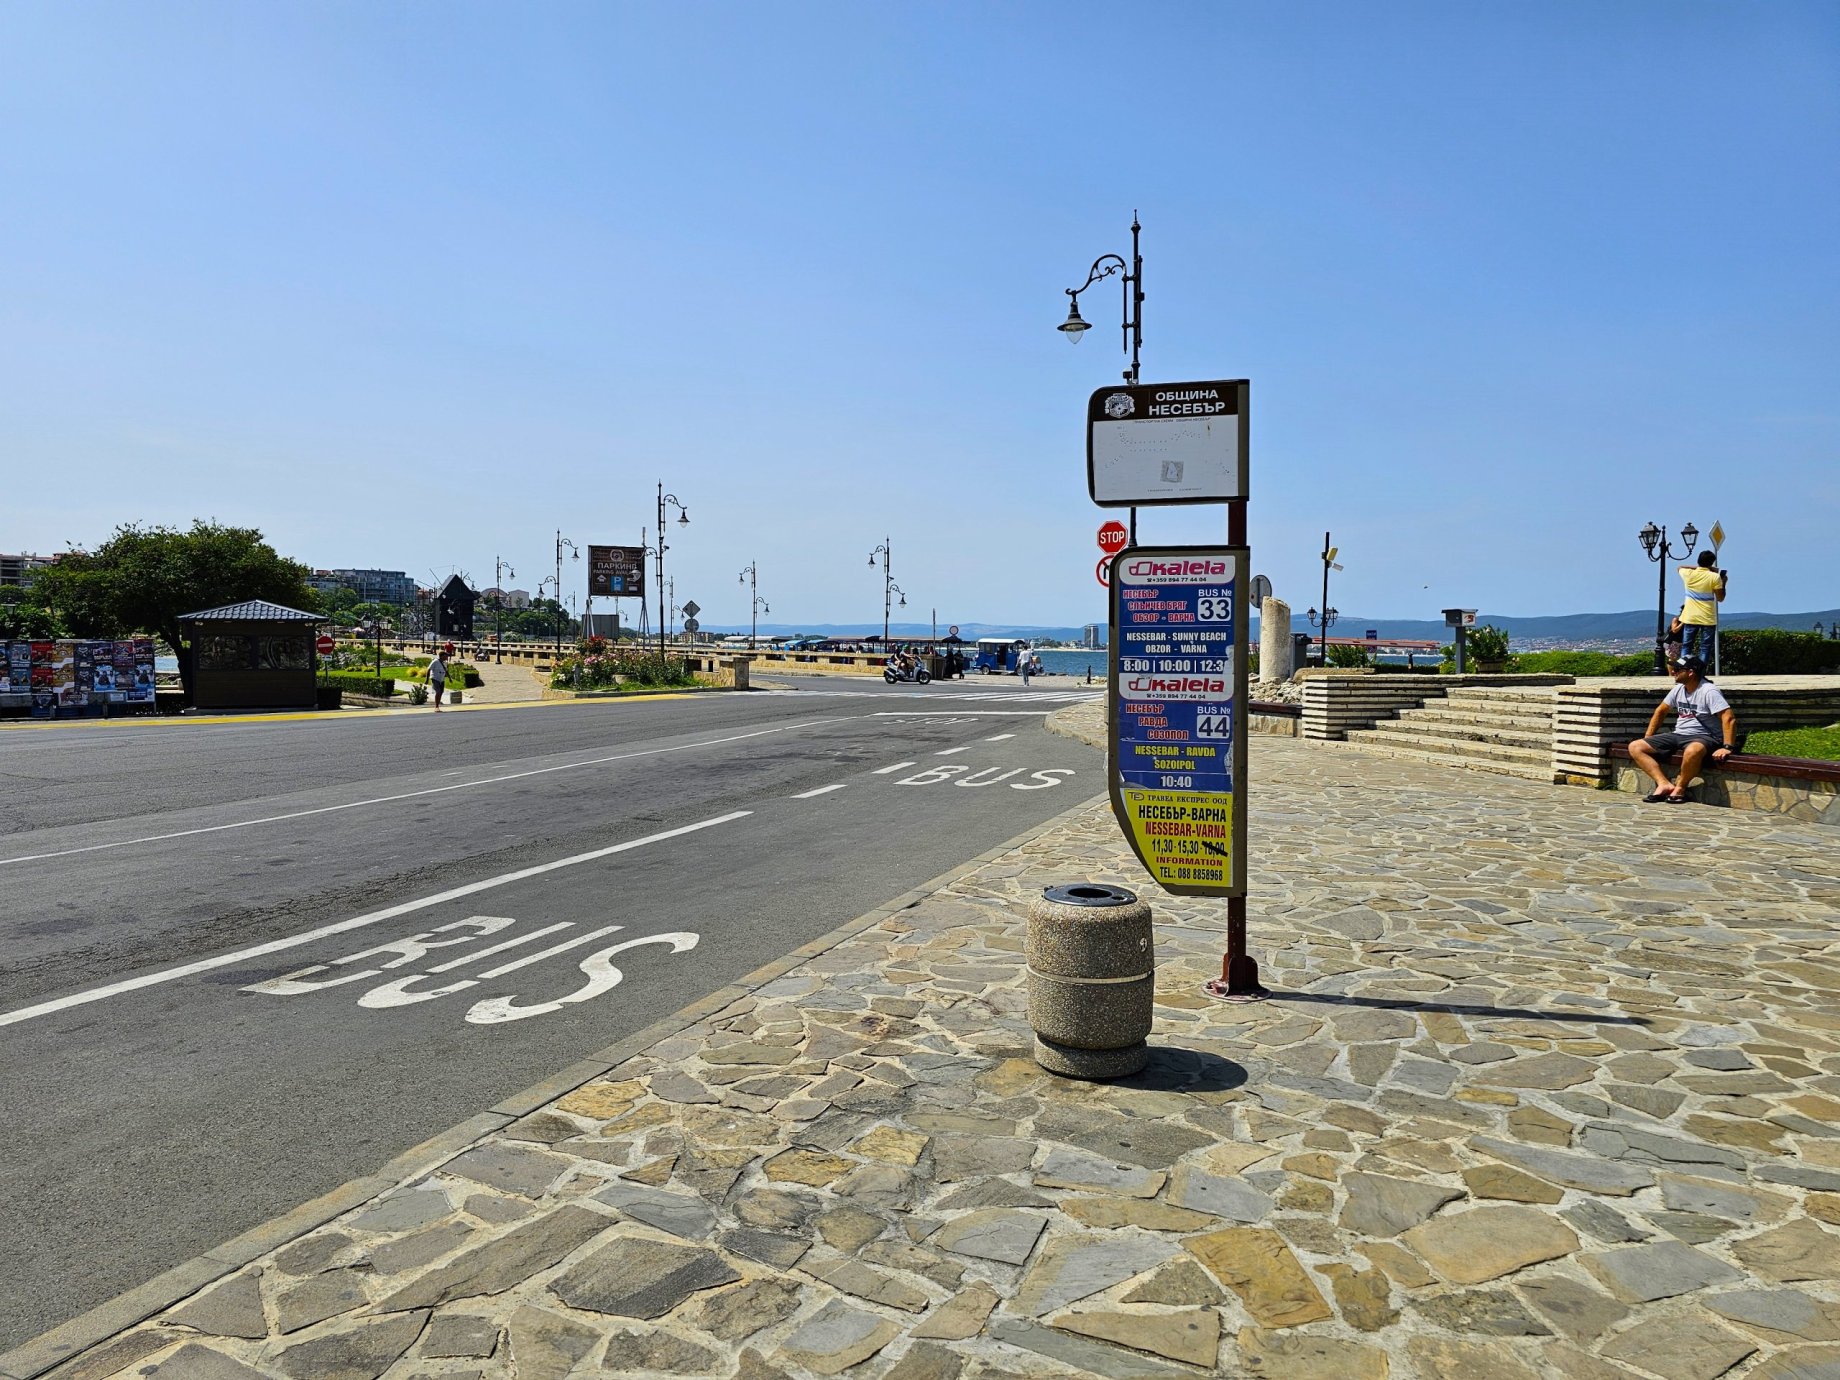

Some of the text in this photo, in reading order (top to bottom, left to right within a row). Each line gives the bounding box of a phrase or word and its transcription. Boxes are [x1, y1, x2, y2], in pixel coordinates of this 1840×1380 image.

[1155, 390, 1218, 402] ОБЩИНА
[1149, 402, 1225, 416] НЕСЕБЪР
[1100, 531, 1124, 544] STOP
[1123, 589, 1159, 599] НЕСЕБЪР
[1128, 601, 1187, 610] СЛЪНЧЕВ БРЯГ
[1200, 599, 1230, 620] 33
[1133, 613, 1159, 622] ОБЗОР
[1168, 613, 1195, 622] ВАРНА
[1127, 633, 1166, 641] NESSEBAR
[1146, 645, 1170, 653] OBZOR
[1181, 645, 1207, 653] VARNA
[1124, 660, 1224, 672] 8:00 10:00 12:3
[1126, 704, 1164, 714] НЕСЕБЪР
[1138, 717, 1168, 727] РАВДА
[1199, 717, 1229, 736] 44
[1147, 730, 1189, 740] СОЗОПОЛ
[1136, 746, 1179, 755] NESSEBAR
[1186, 747, 1216, 756] RAVDA
[893, 765, 1076, 790] BUS
[1161, 776, 1192, 787] 10:40
[1139, 805, 1226, 822] НЕСЕБЪР-ВАРНА
[1146, 822, 1226, 838] NESSEBAR-VARNA
[1152, 839, 1172, 855] 11,30
[1178, 840, 1198, 856] 15,30
[1156, 856, 1222, 866] INFORMATION
[1160, 867, 1176, 878] TEL.:
[1178, 868, 1190, 879] 088
[238, 916, 700, 1024] BUS
